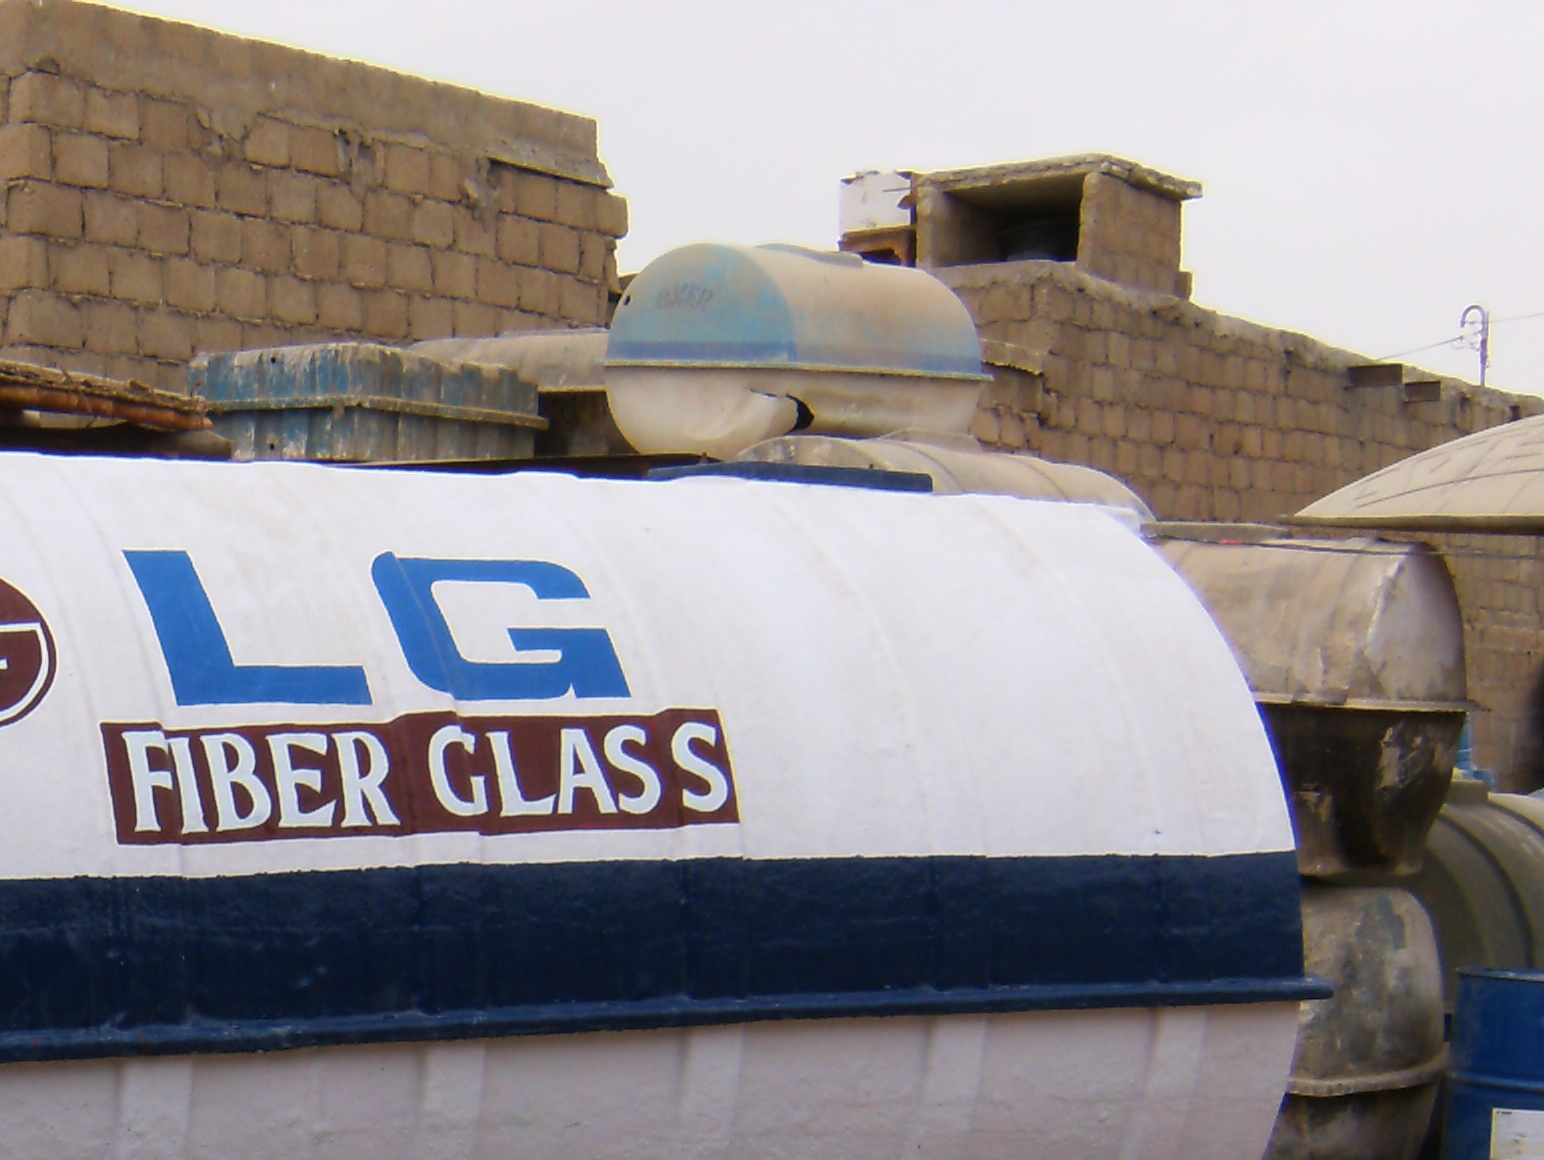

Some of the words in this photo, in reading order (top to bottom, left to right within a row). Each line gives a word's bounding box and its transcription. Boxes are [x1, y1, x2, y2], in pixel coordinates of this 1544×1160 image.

[122, 549, 631, 706] LG
[124, 729, 401, 834] FIBER
[427, 721, 730, 817] GLASS
